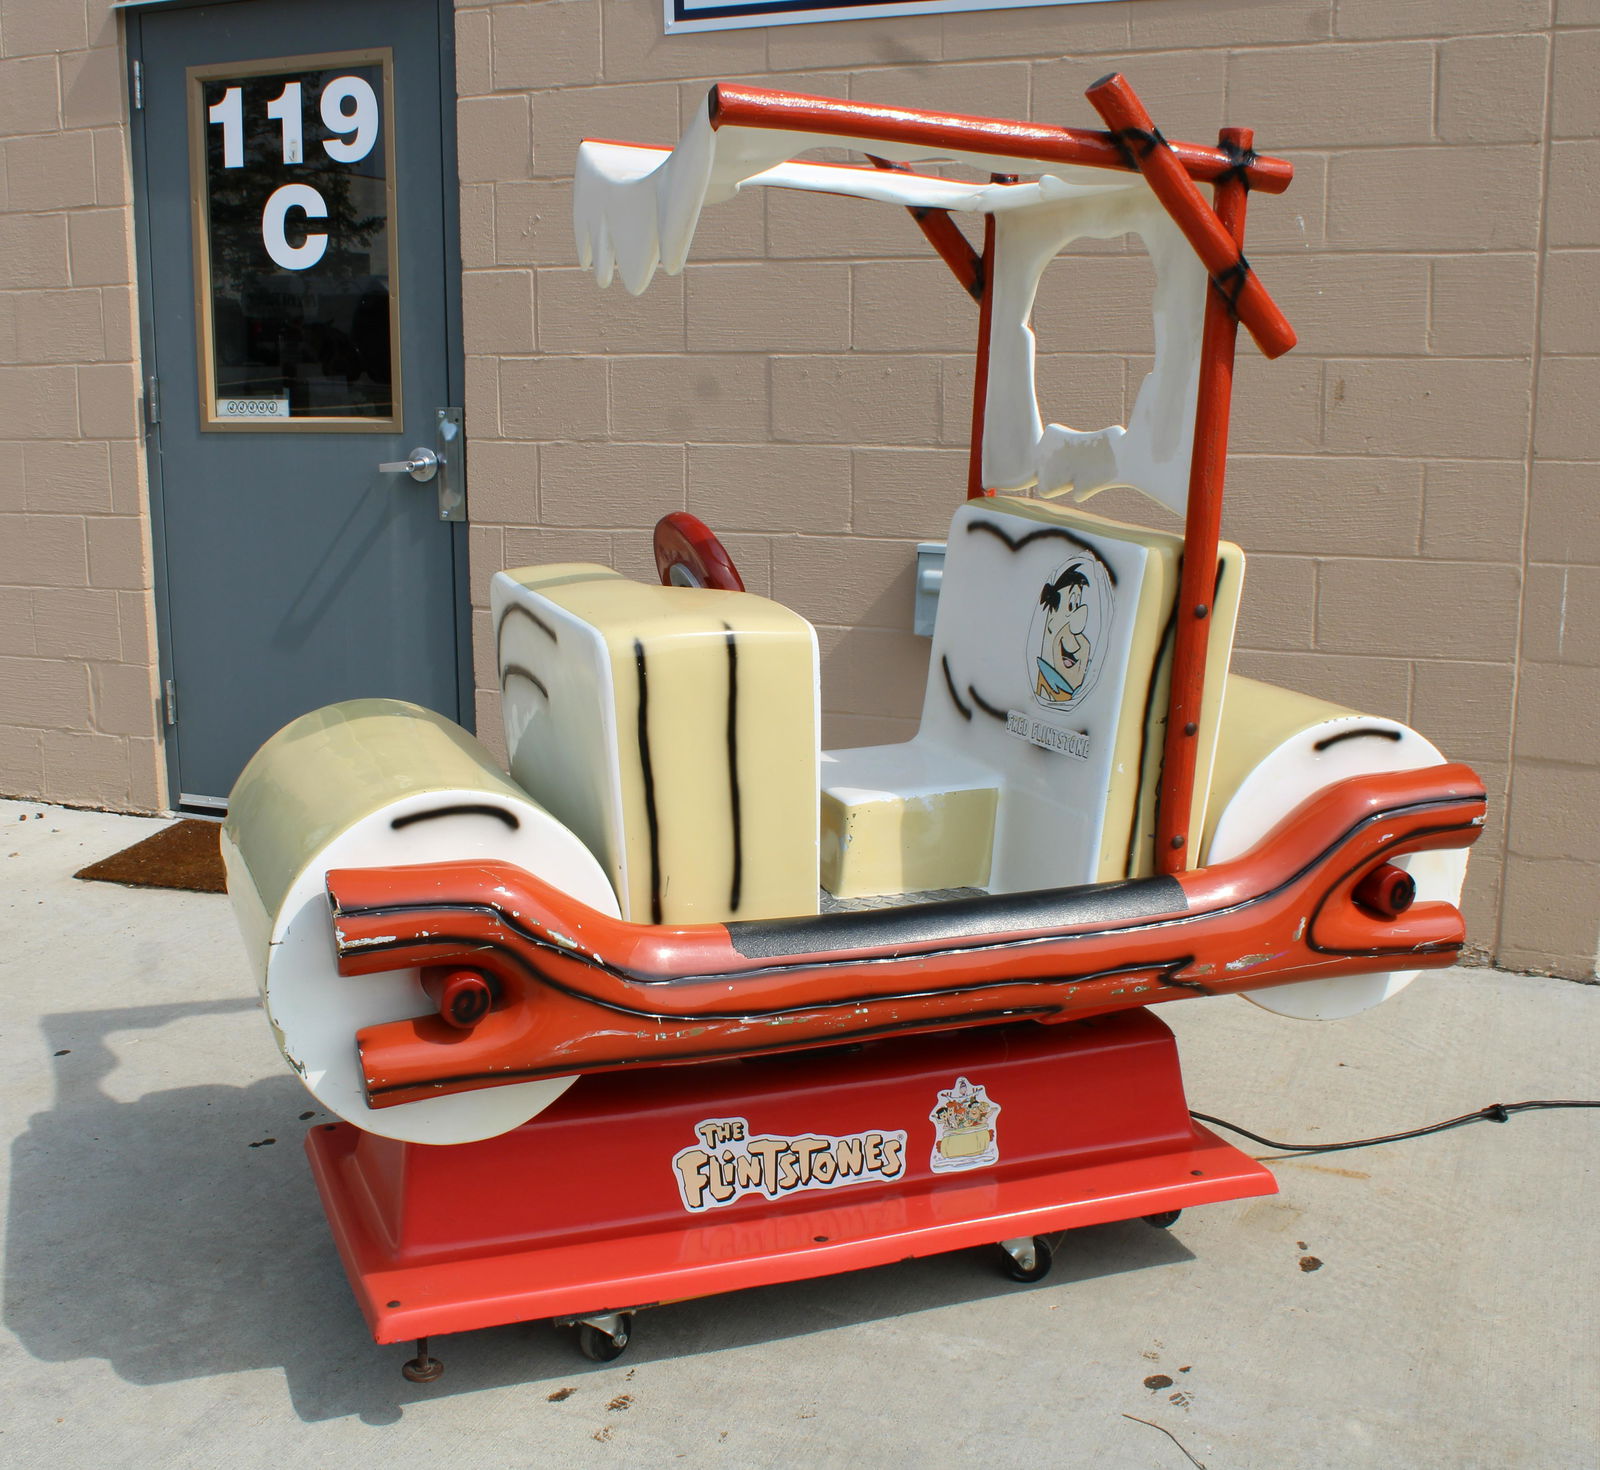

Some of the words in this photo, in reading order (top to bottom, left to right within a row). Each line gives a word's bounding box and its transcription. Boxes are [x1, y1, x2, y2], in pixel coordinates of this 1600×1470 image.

[208, 75, 379, 168] 119
[262, 183, 329, 271] C
[1006, 713, 1028, 737] FRED
[1031, 722, 1090, 759] FLINTSTONE
[699, 1121, 745, 1149] THE
